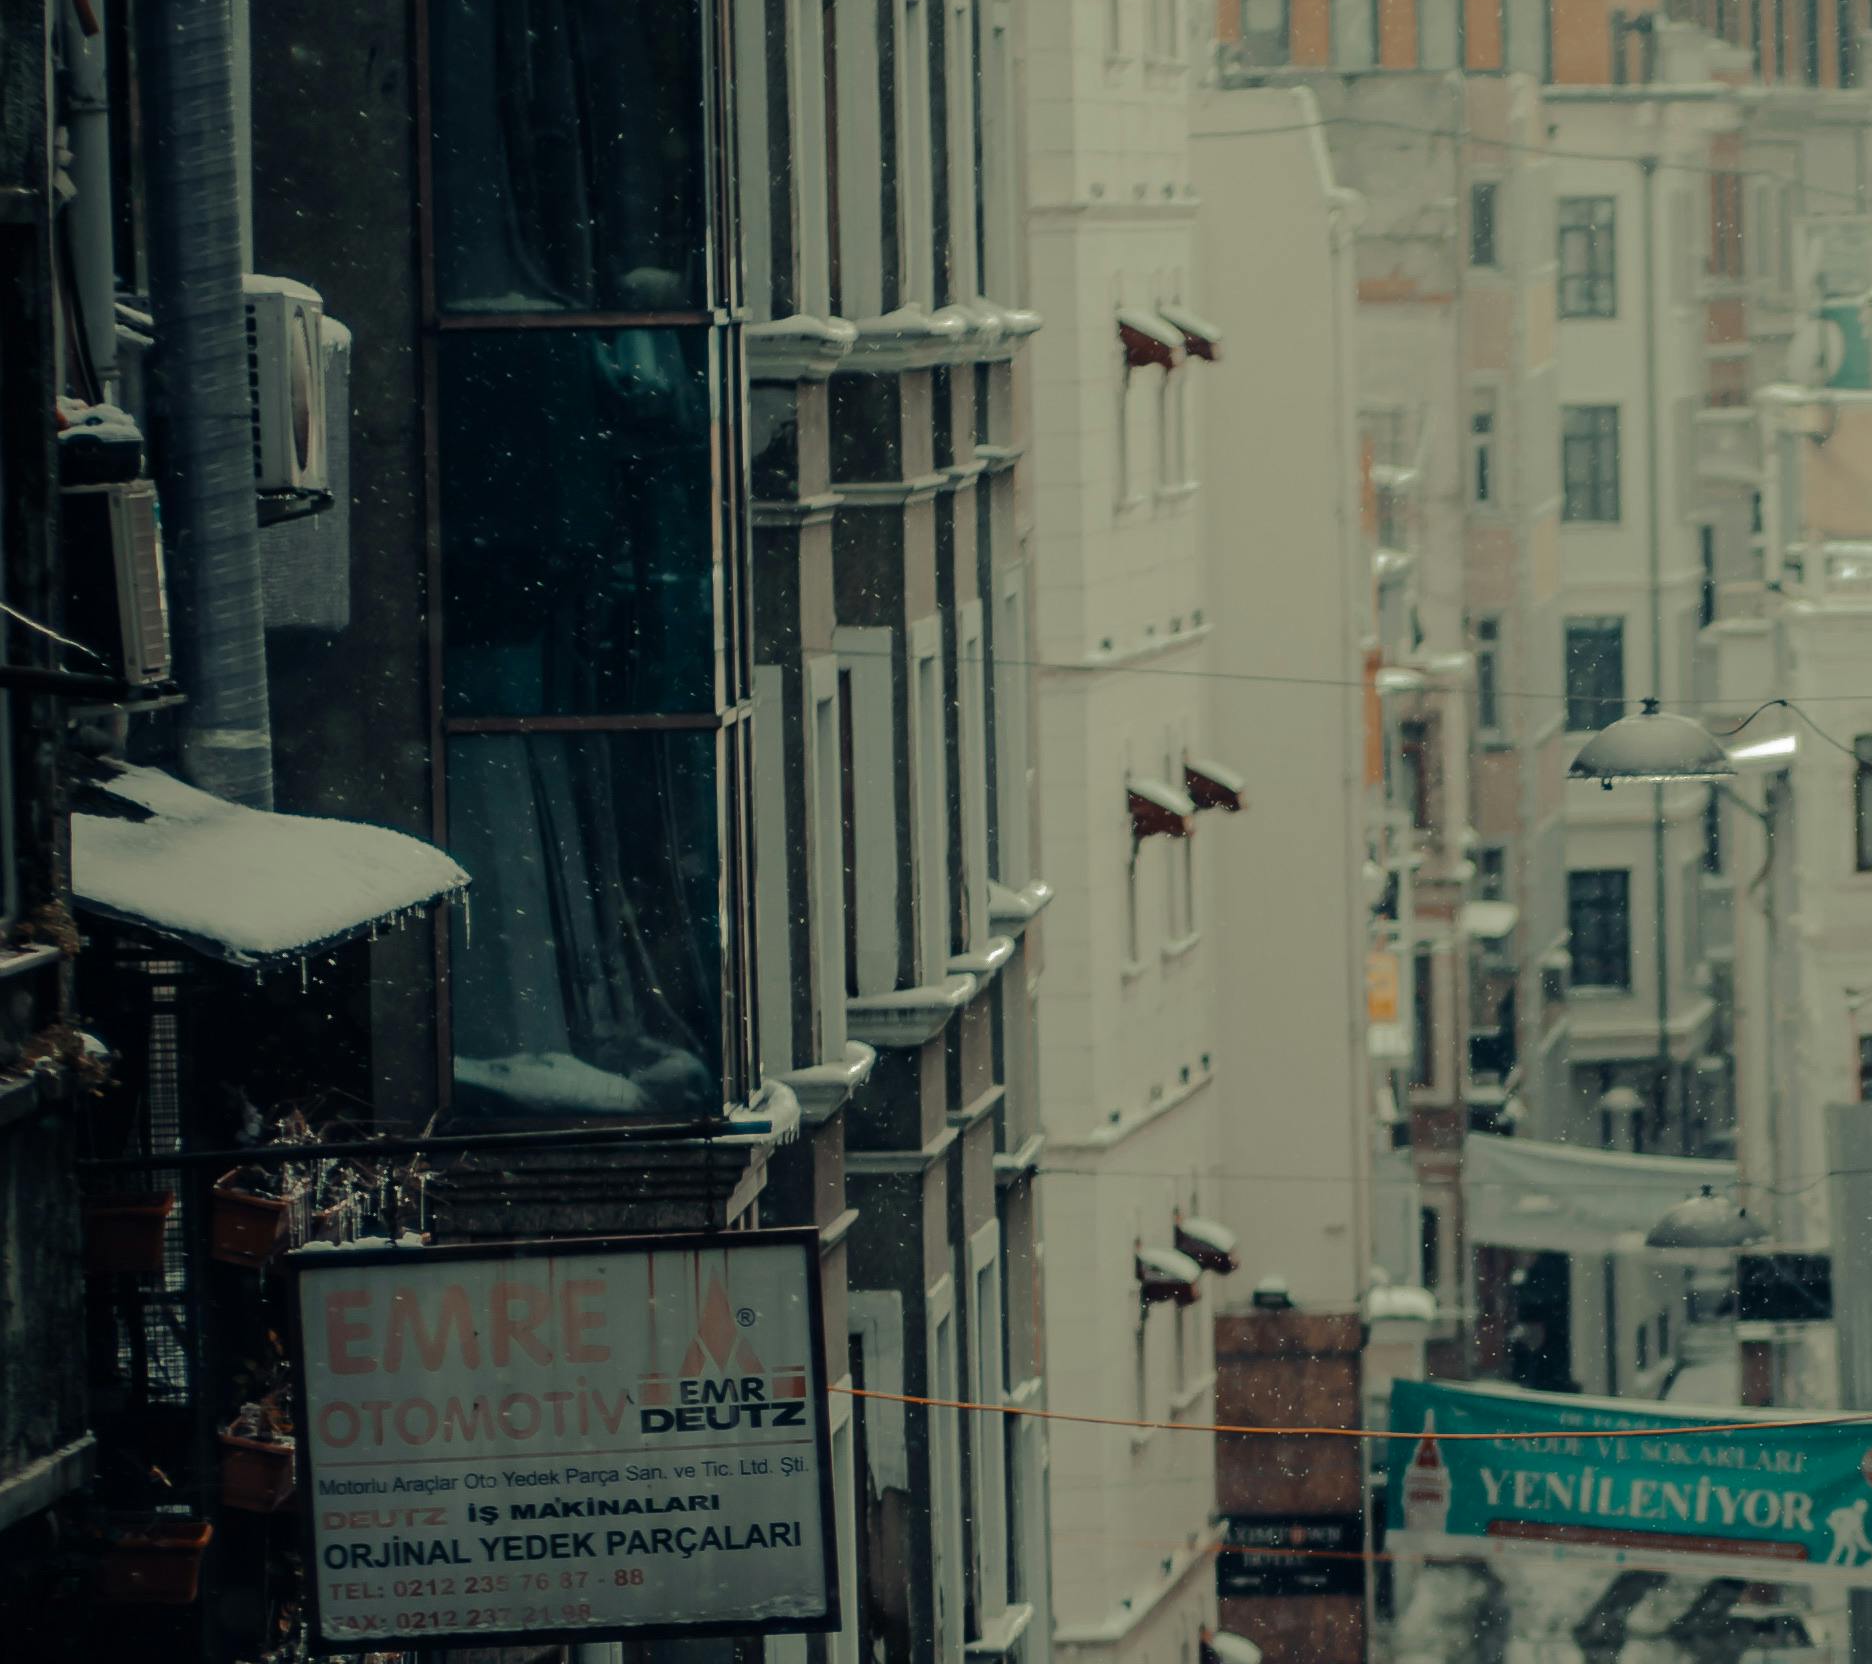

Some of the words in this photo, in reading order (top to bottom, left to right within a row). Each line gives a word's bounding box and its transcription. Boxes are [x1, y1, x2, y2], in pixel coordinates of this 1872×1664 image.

[325, 1279, 611, 1375] EMRE
[680, 1377, 765, 1405] EMR
[318, 1376, 629, 1448] OTOMOTİV
[639, 1401, 806, 1433] DEUTZ
[318, 1478, 388, 1496] Motorlu
[392, 1476, 459, 1495] Araçlar
[463, 1472, 497, 1489] Oto
[502, 1469, 561, 1487] Yedek
[565, 1467, 619, 1486] Parça
[625, 1465, 667, 1481] San.
[673, 1466, 696, 1478] ve
[739, 1458, 773, 1476] Ltd.
[1479, 1465, 1815, 1532] YENİLENİYOR
[322, 1507, 449, 1531] DEUTZ
[325, 1535, 473, 1571] ORJİNAL
[479, 1532, 597, 1562] YEDEK
[606, 1521, 802, 1559] PARÇALARI
[328, 1582, 385, 1601] TEL:
[393, 1578, 455, 1598] 0212
[519, 1572, 550, 1591] 76
[613, 1568, 645, 1587] 88
[395, 1609, 458, 1629] 0212
